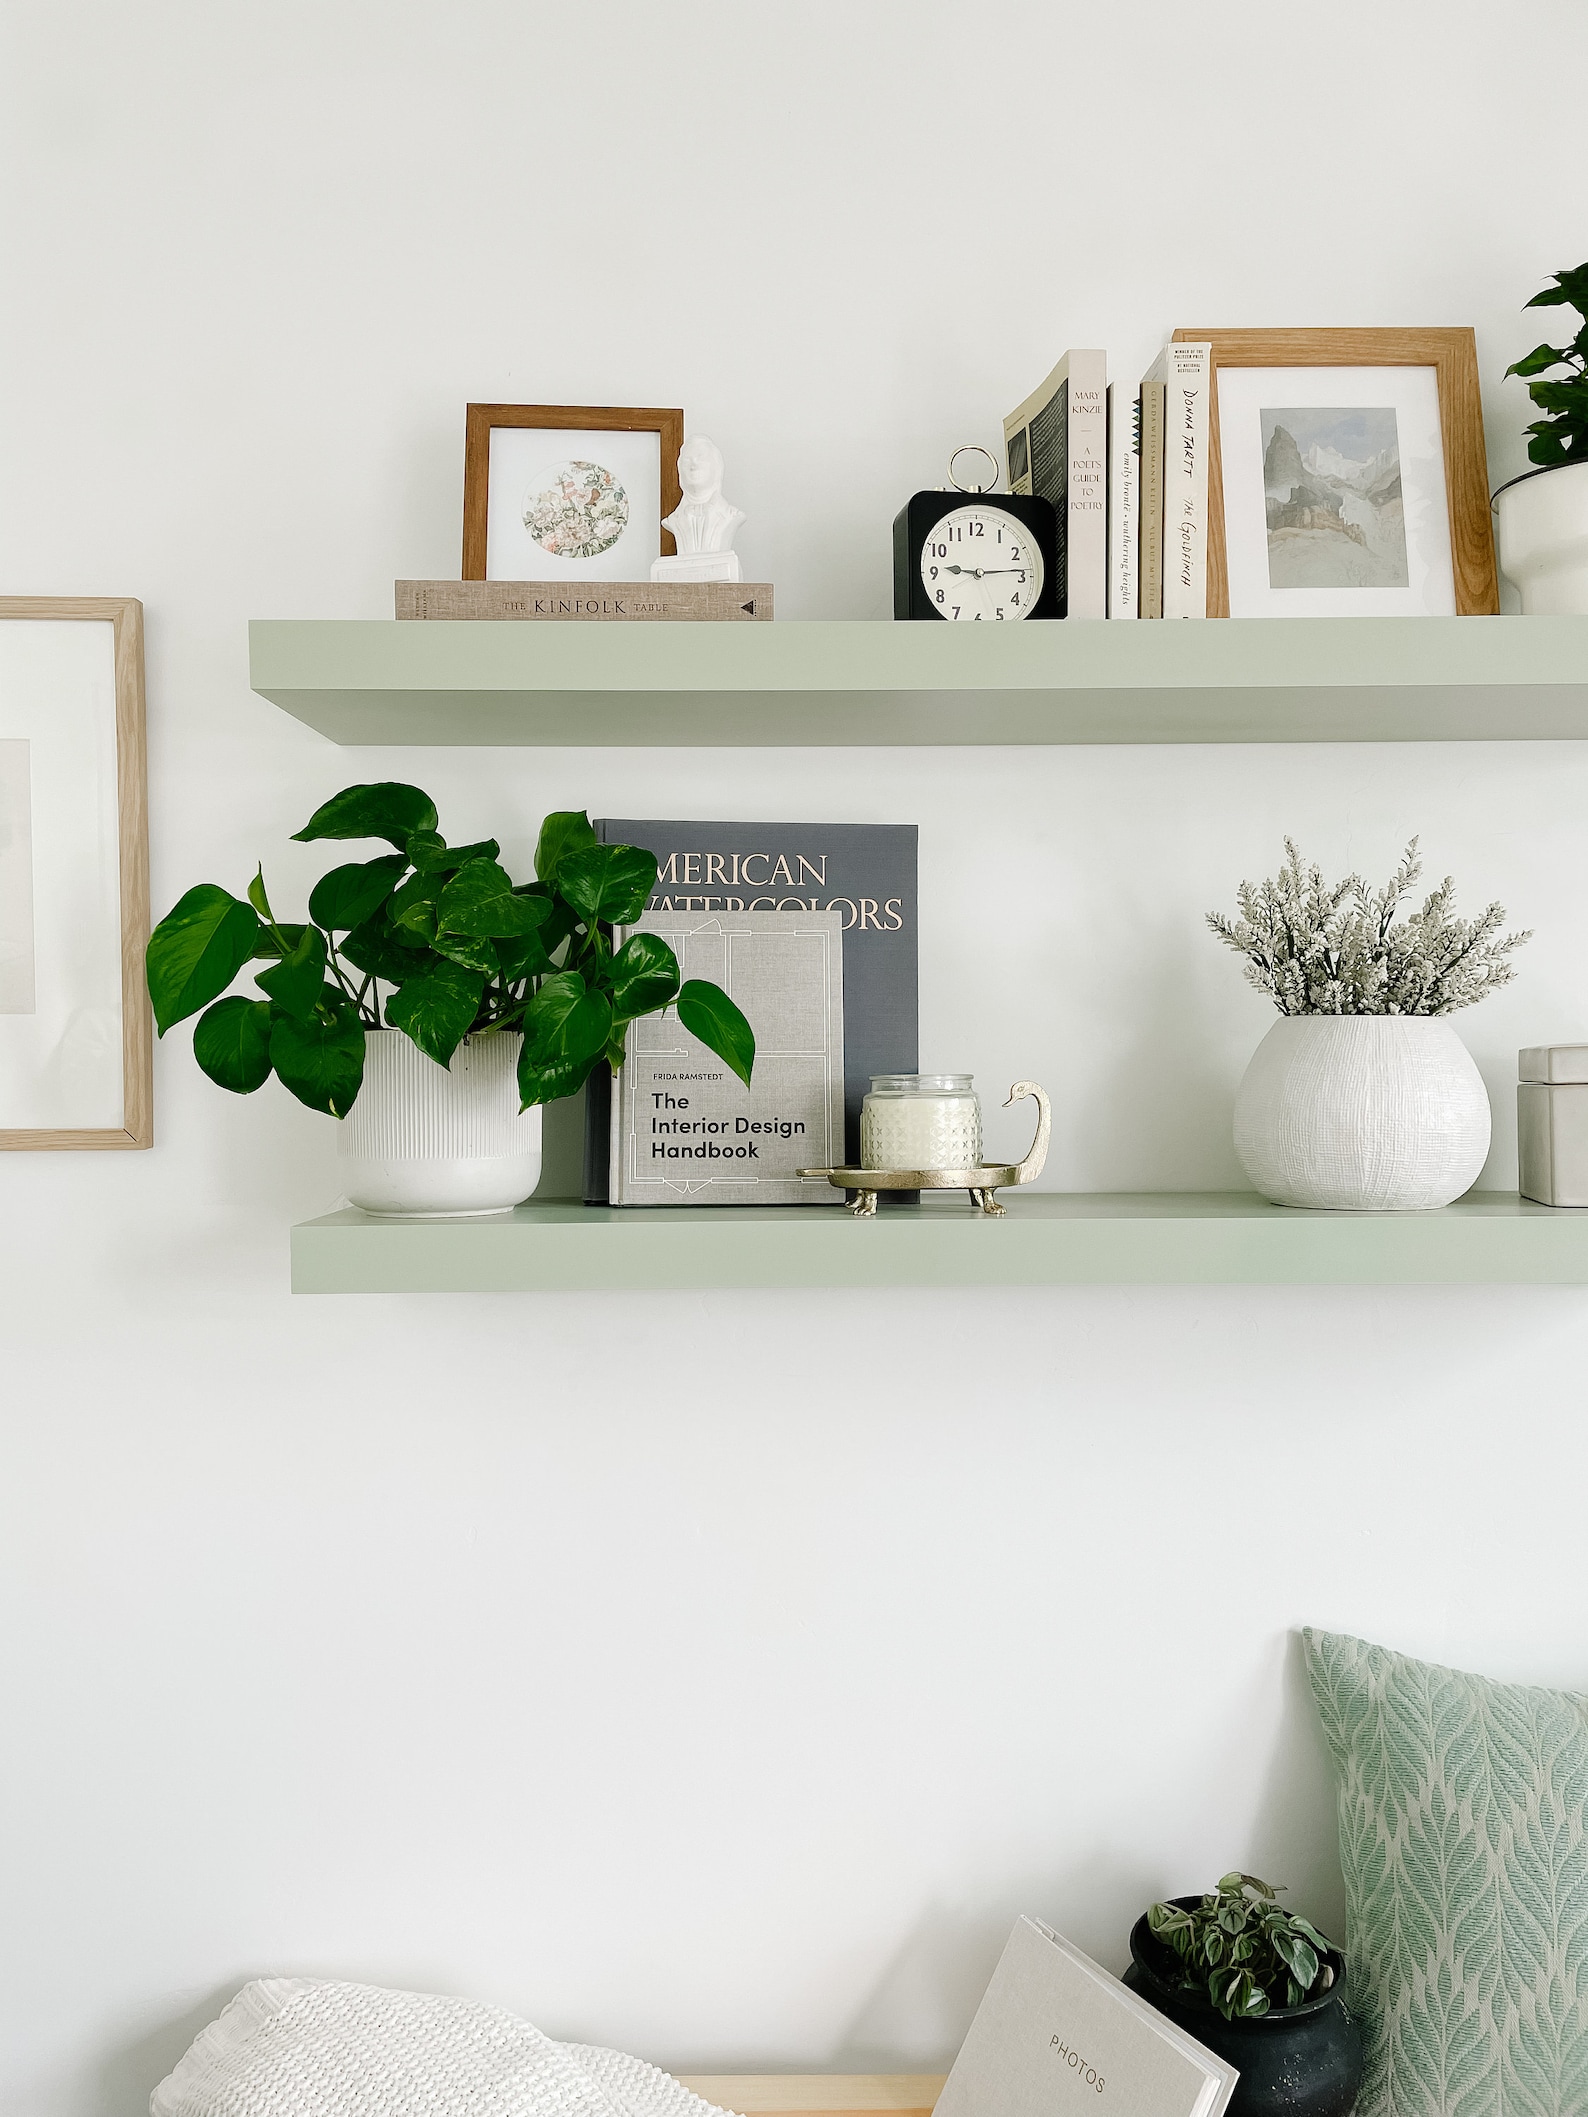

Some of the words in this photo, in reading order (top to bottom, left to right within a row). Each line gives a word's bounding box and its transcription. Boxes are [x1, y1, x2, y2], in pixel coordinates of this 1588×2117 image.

[1074, 391, 1099, 400] MARY
[1072, 405, 1102, 414] KINZIE
[1182, 388, 1198, 430] DONNA
[1084, 447, 1091, 455] A
[1181, 434, 1195, 478] TARTT
[1121, 453, 1132, 479] emily
[1072, 474, 1101, 482] GUIDE
[1081, 488, 1094, 496] TO
[1070, 501, 1103, 510] POETRY
[949, 527, 961, 542] 11
[969, 521, 984, 537] 12
[998, 529, 1001, 543] 1
[931, 543, 947, 558] 10
[1120, 520, 1131, 570] wuthering
[1011, 547, 1020, 561] 2
[930, 566, 938, 580] 9
[1017, 570, 1026, 583] 3
[1120, 571, 1131, 605] heights
[936, 589, 945, 603] 8
[1011, 592, 1020, 606] 4
[502, 602, 527, 611] THE
[534, 599, 627, 614] KINFOLK
[633, 603, 669, 612] TABLE
[952, 606, 961, 620] 7
[996, 608, 1004, 620] 5
[656, 852, 829, 887] MERICAN
[653, 1073, 678, 1081] FRIDA
[679, 1073, 724, 1081] RAMSTEDT
[651, 1092, 690, 1110] The
[652, 1117, 730, 1134] Interior
[735, 1117, 806, 1139] Design
[652, 1141, 760, 1159] Handbook
[1049, 2034, 1106, 2094] PHOTOS
